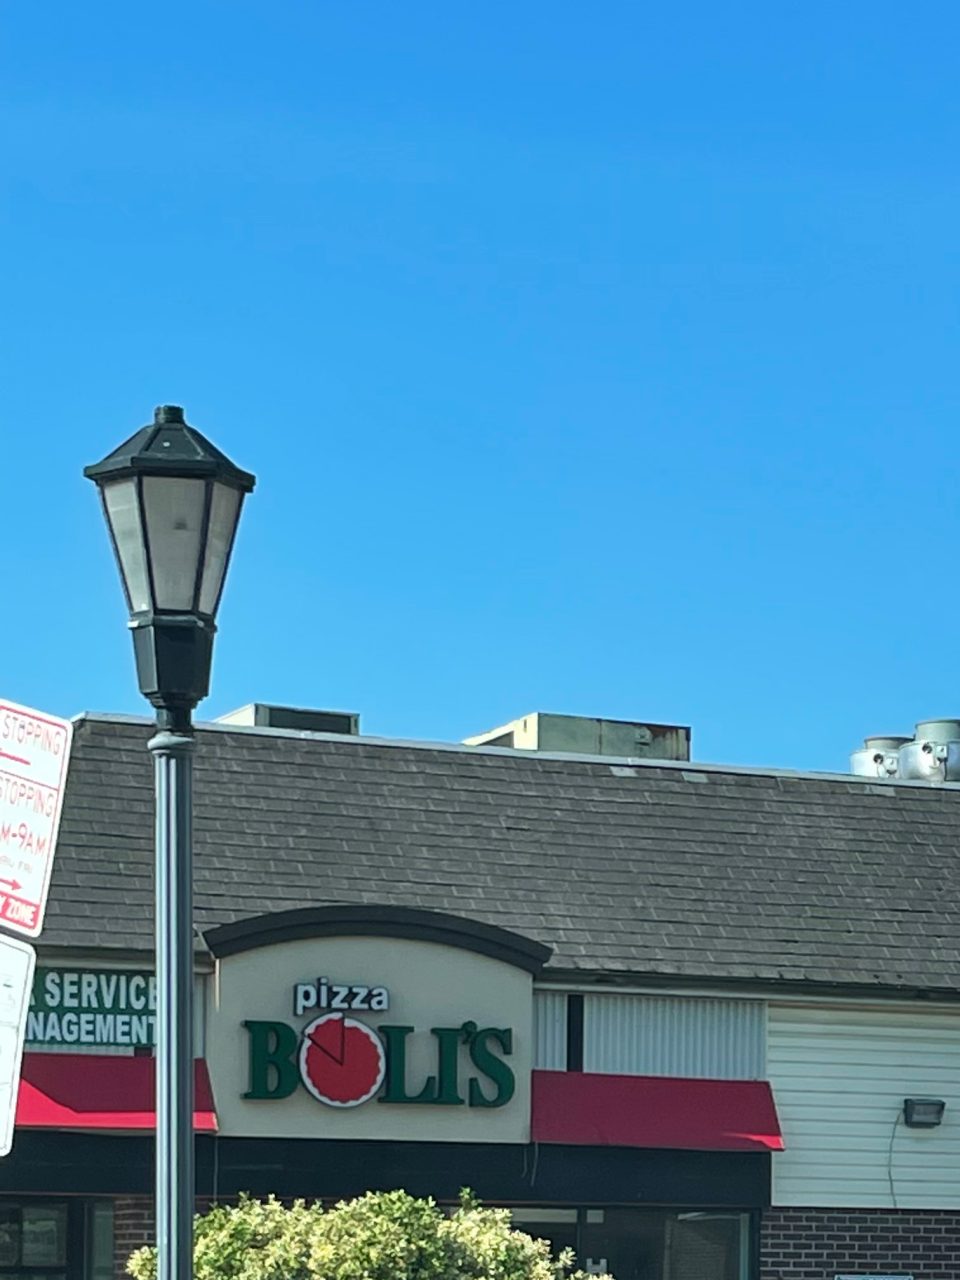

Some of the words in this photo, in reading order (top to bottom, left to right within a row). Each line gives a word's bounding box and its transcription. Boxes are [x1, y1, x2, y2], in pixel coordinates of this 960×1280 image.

[3, 714, 61, 755] STOPPING
[0, 821, 47, 857] M-9AM
[294, 976, 389, 1015] pizza
[28, 1011, 157, 1044] NAGEMENT
[240, 1012, 515, 1108] BOLI'S
